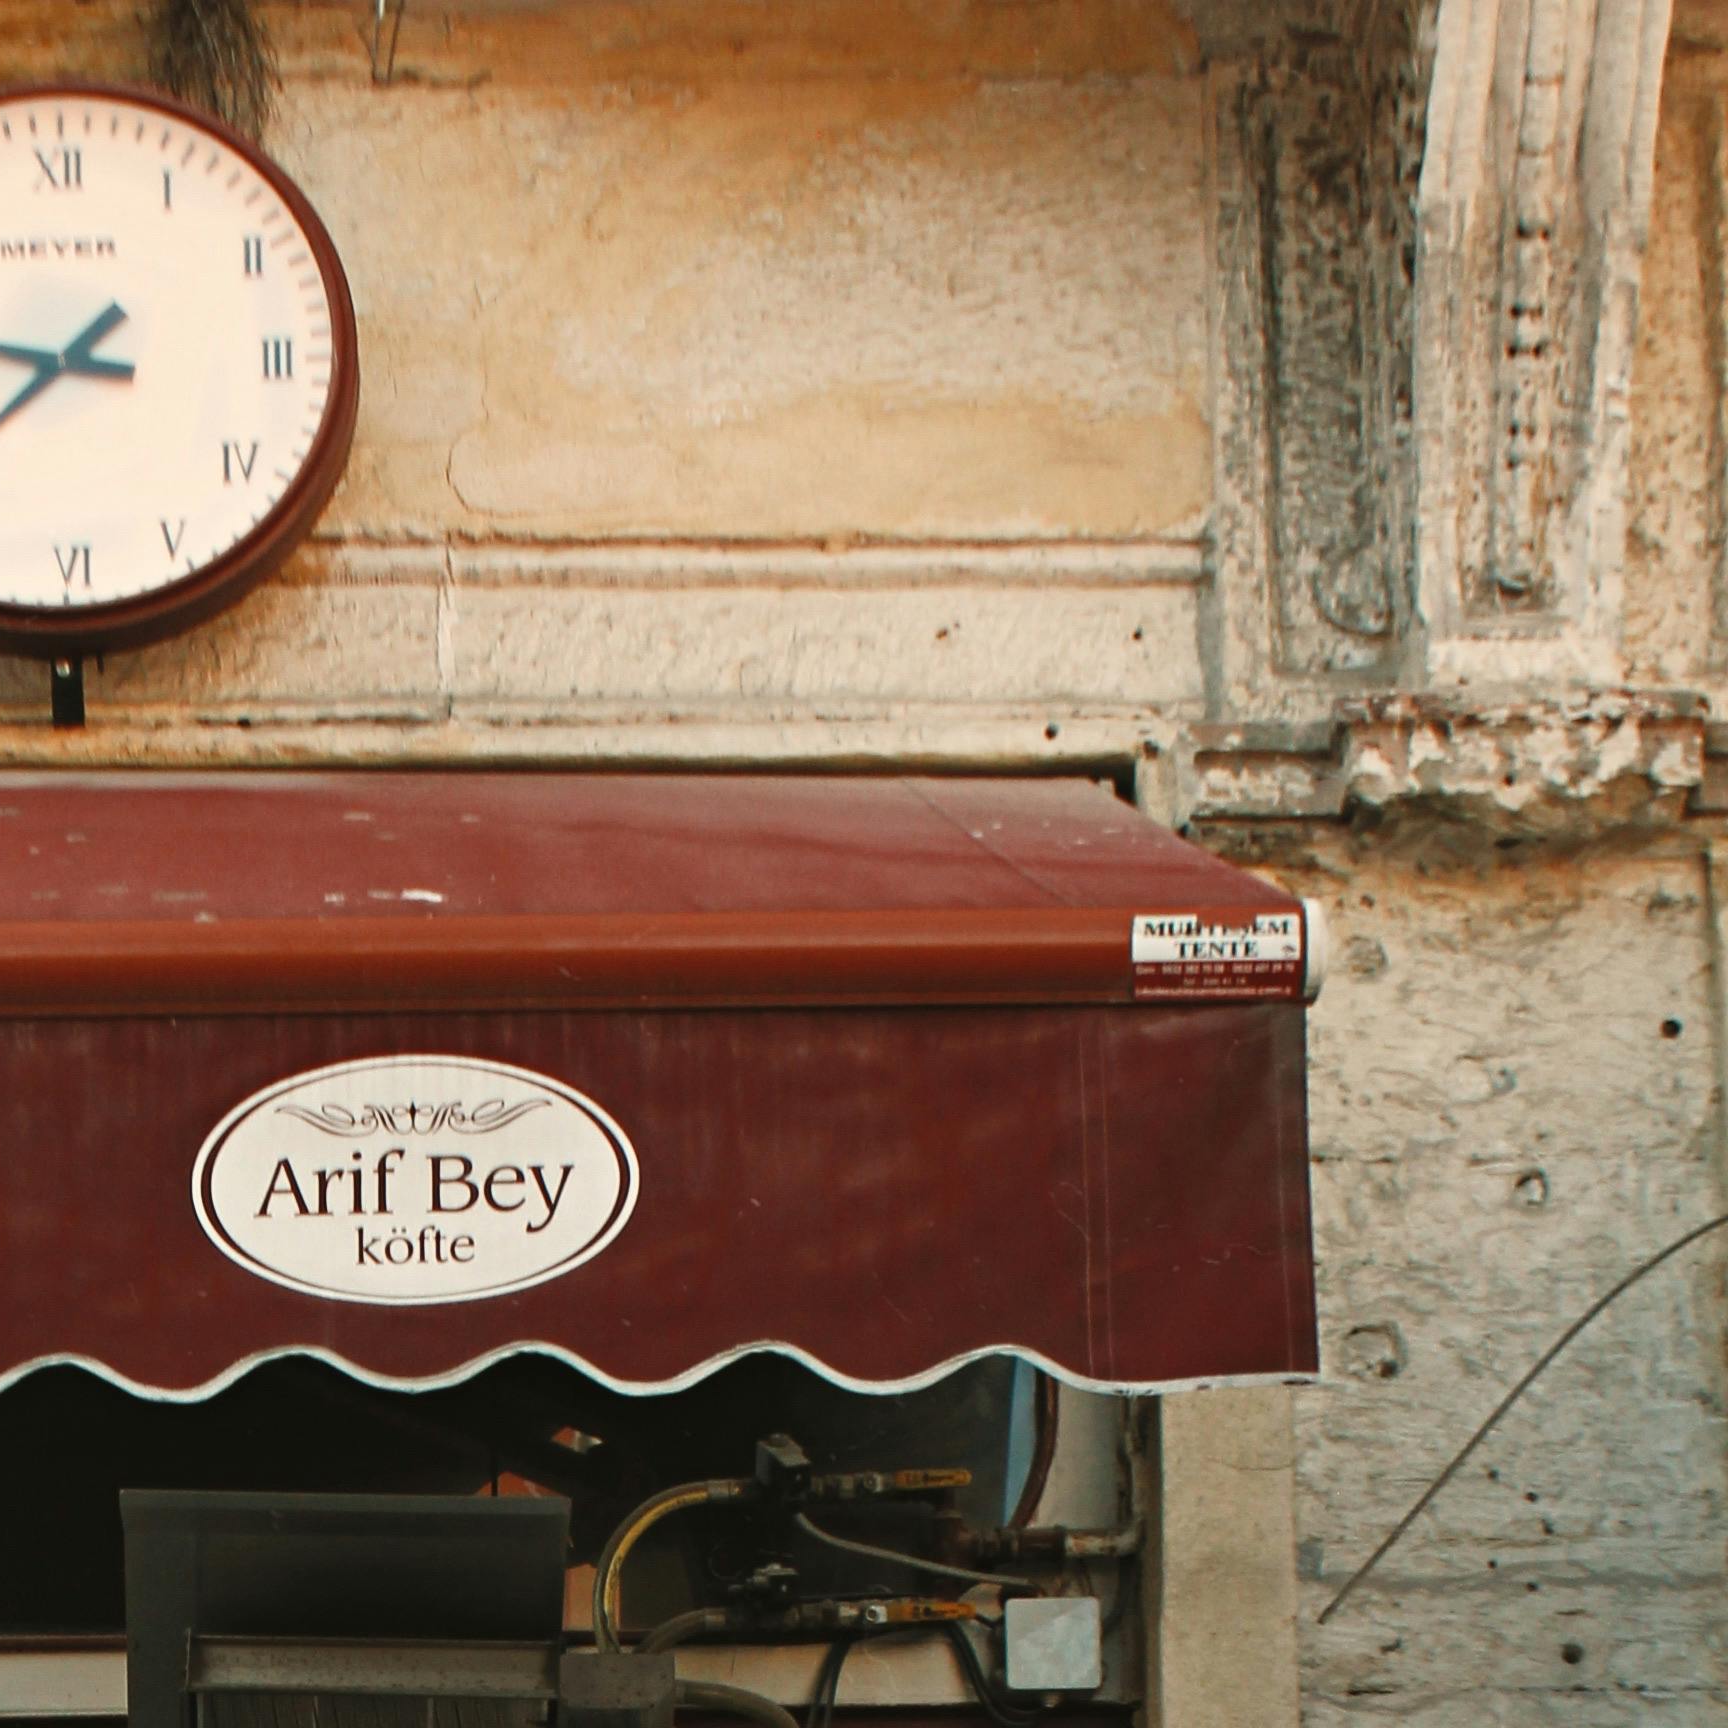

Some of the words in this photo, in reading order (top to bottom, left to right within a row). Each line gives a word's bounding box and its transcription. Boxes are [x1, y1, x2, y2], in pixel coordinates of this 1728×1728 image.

[34, 146, 83, 190] XII
[161, 167, 173, 212] I
[0, 237, 118, 260] MEYER
[242, 236, 263, 277] II
[261, 338, 293, 380] III
[222, 441, 260, 484] IV
[160, 520, 187, 562] V
[54, 546, 94, 587] VI
[1175, 941, 1259, 959] TENTE
[253, 1147, 406, 1219] Arif
[425, 1154, 575, 1234] Bey
[354, 1225, 476, 1267] köfte
